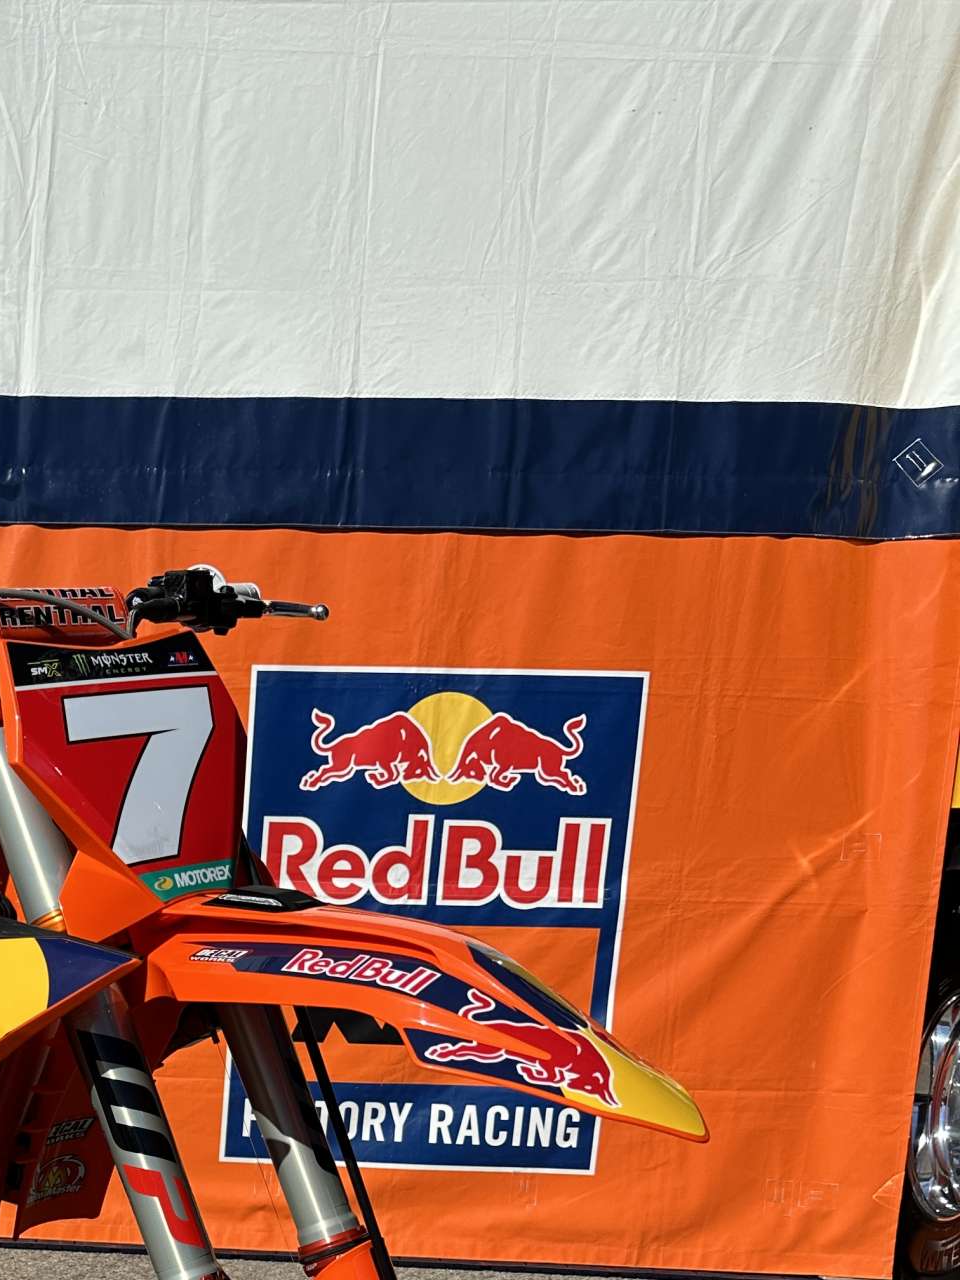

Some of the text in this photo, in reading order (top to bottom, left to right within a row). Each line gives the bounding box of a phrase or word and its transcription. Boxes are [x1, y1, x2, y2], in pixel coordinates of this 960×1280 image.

[91, 653, 153, 667] MONSTER
[106, 666, 147, 675] ENERGY
[63, 686, 214, 864] 7
[174, 865, 232, 888] MOTOREX
[263, 814, 612, 909] Red Bull
[281, 949, 441, 996] Red Bull
[428, 1103, 582, 1149] RACING
